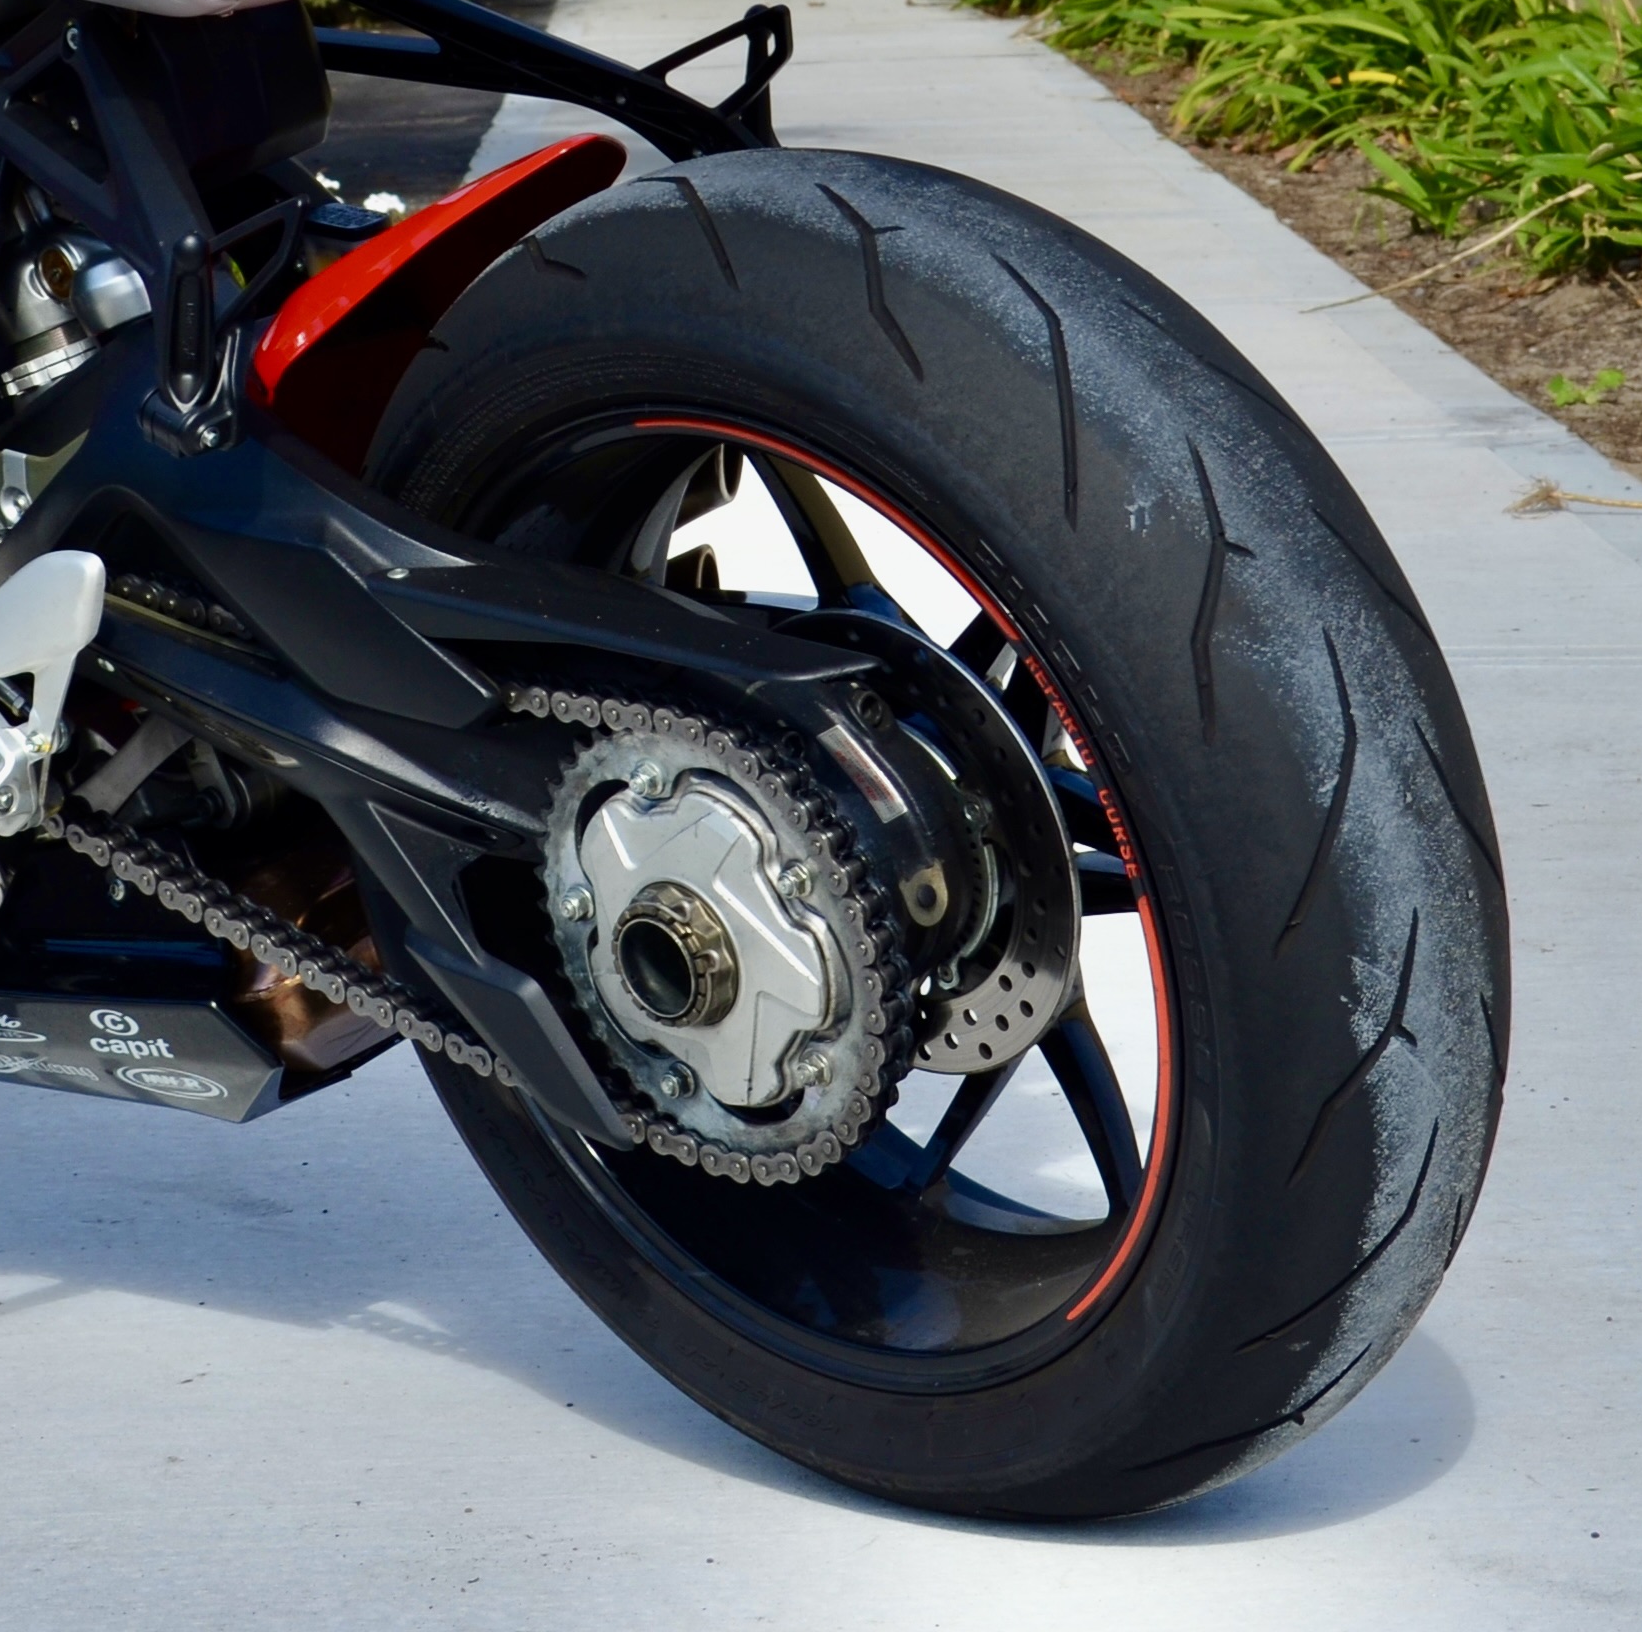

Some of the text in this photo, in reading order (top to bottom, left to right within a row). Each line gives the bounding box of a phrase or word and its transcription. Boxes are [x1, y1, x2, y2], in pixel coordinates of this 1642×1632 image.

[1024, 654, 1140, 880] REPARTO CORSE
[89, 1036, 175, 1059] capit
